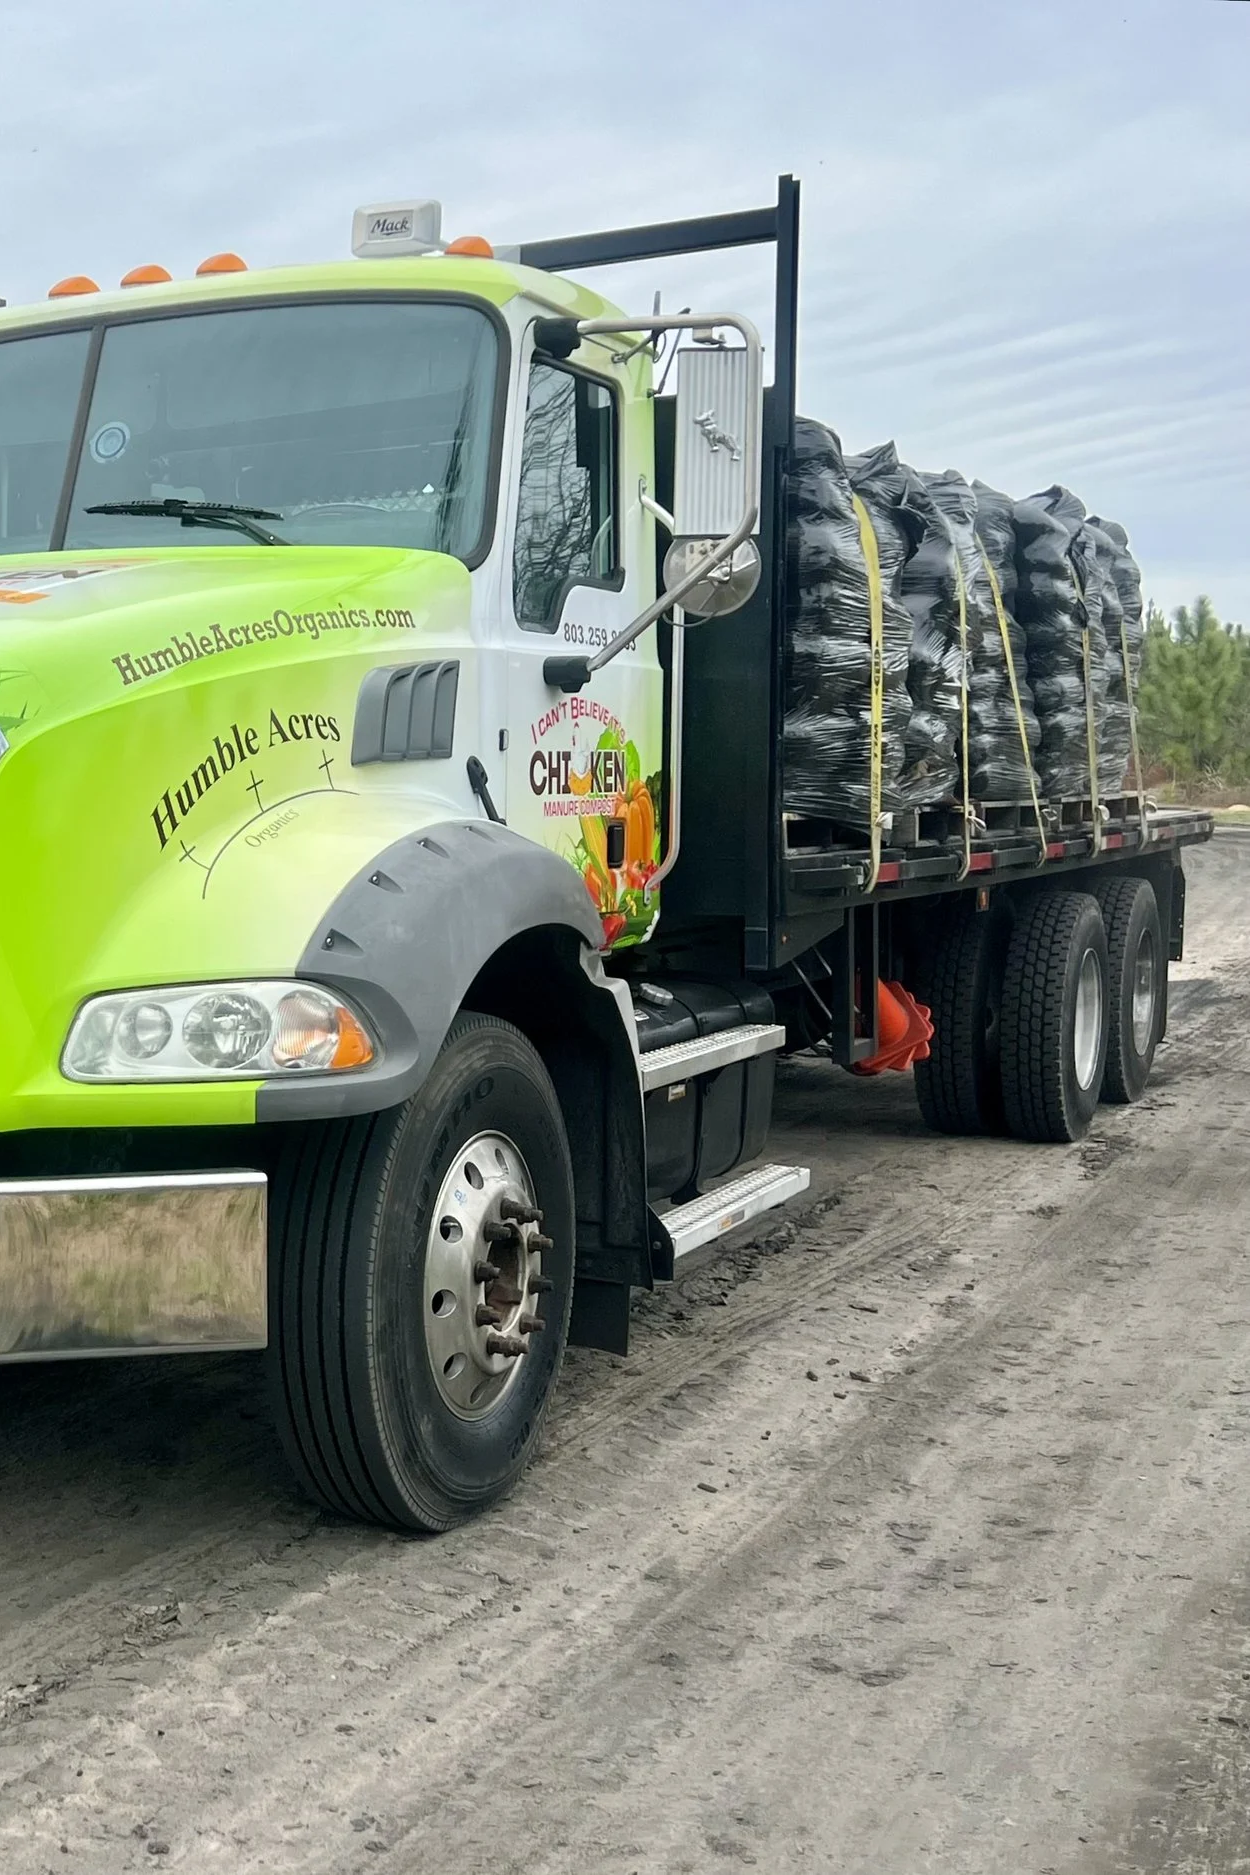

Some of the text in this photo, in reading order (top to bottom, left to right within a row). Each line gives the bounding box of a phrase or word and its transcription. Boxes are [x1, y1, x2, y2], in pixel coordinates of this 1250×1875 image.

[370, 217, 410, 235] Mack
[111, 603, 416, 685] HumbleAcresOrganics.com
[531, 724, 537, 745] I
[538, 702, 567, 736] CAN'T
[570, 697, 610, 726] BELIEVE
[150, 708, 341, 852] Humble Acres
[530, 750, 625, 795] CHIKEN
[244, 807, 299, 849] Organics
[544, 798, 615, 817] MANURE COMPOST
